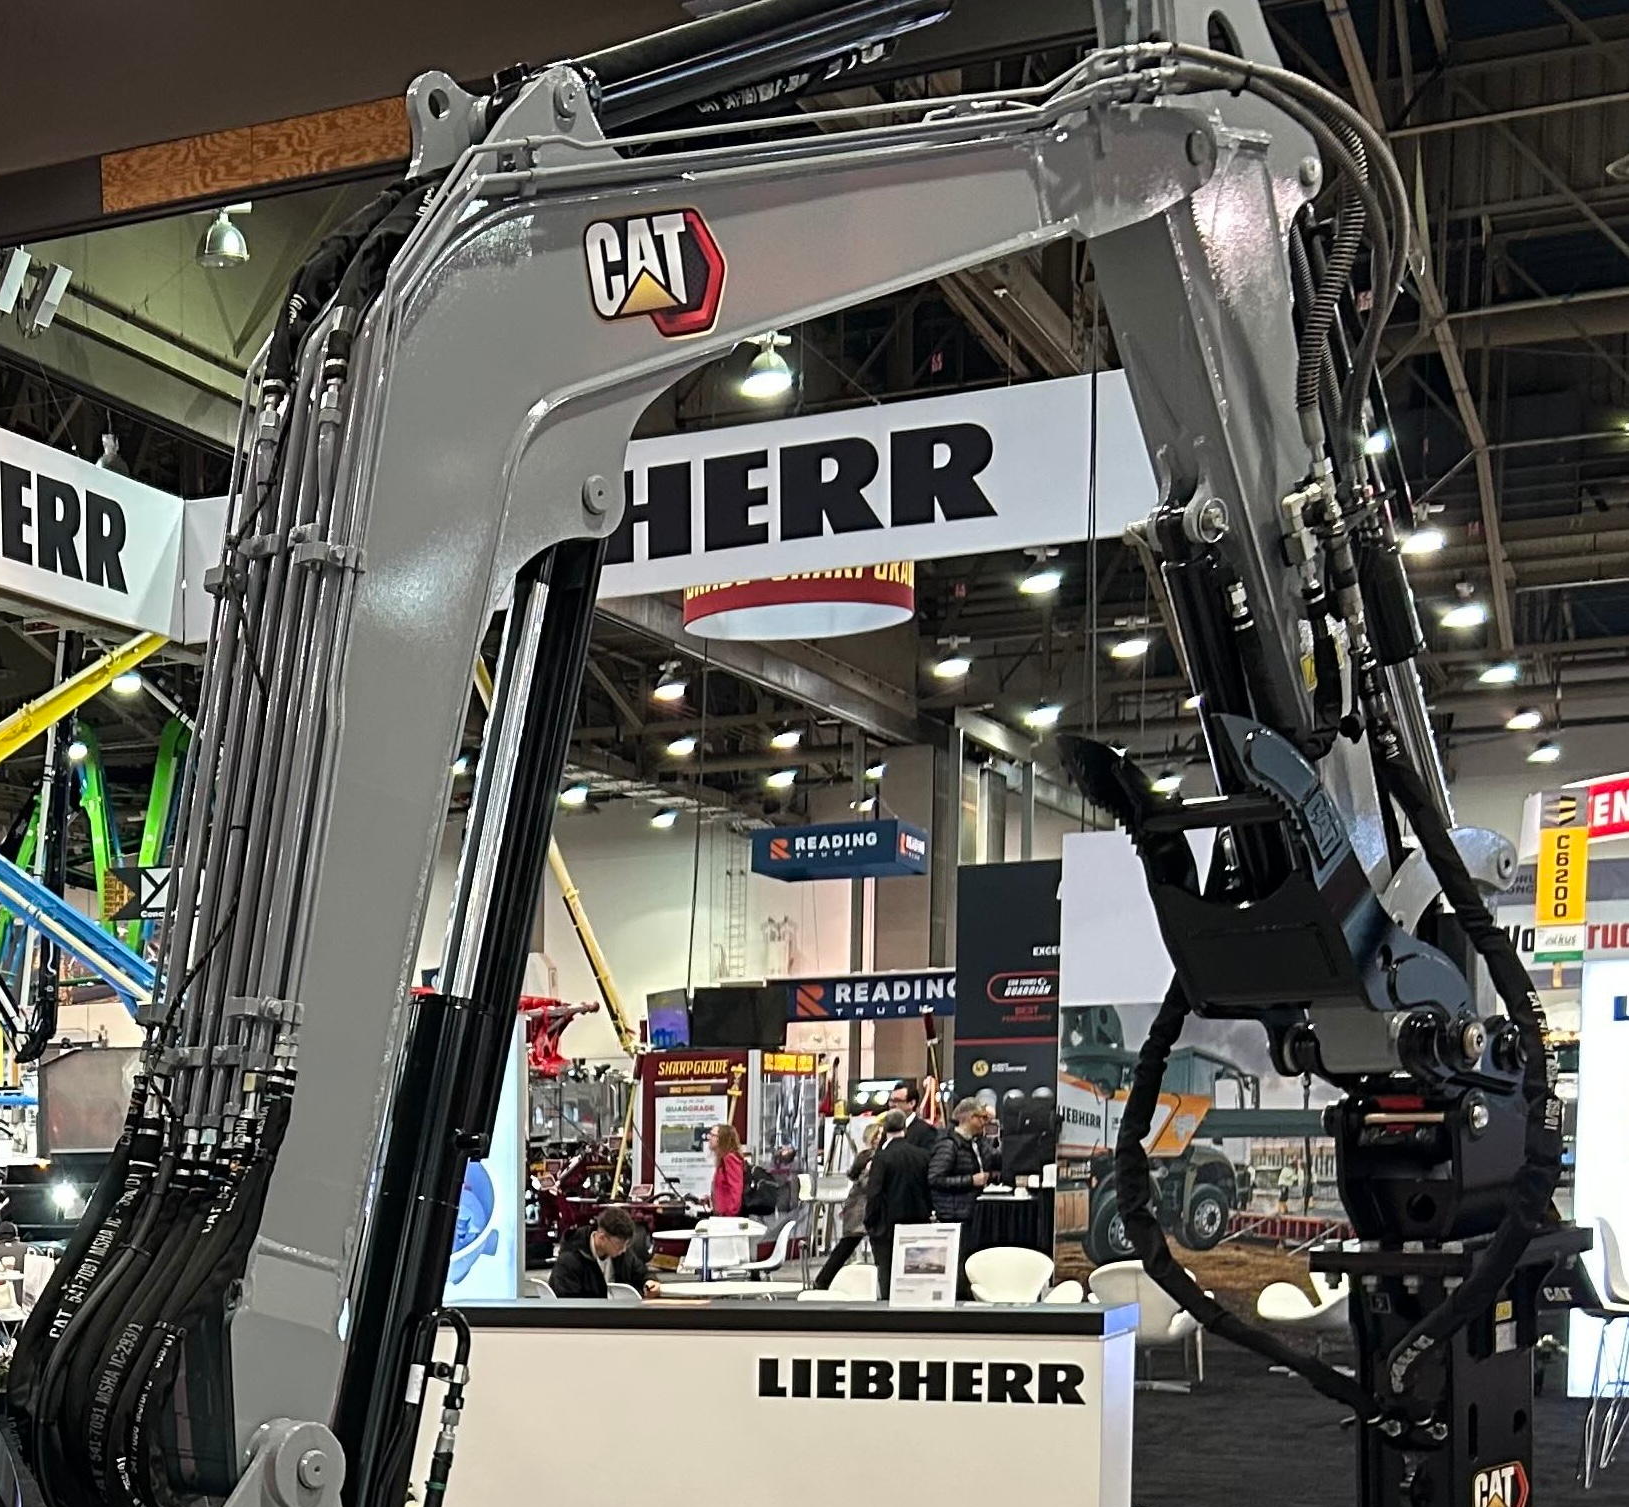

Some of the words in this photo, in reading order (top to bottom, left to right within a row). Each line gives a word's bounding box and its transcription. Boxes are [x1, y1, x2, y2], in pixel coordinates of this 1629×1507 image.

[586, 213, 687, 317] CAT
[795, 831, 878, 851] READING
[1553, 834, 1571, 918] C6200
[1032, 946, 1061, 957] EXCE
[658, 1059, 730, 1077] SHARPGRADE
[49, 1308, 72, 1339] CAT
[90, 1225, 116, 1267] MSHA
[94, 1364, 120, 1409] MSHA
[758, 1357, 1086, 1406] LIEBHERR
